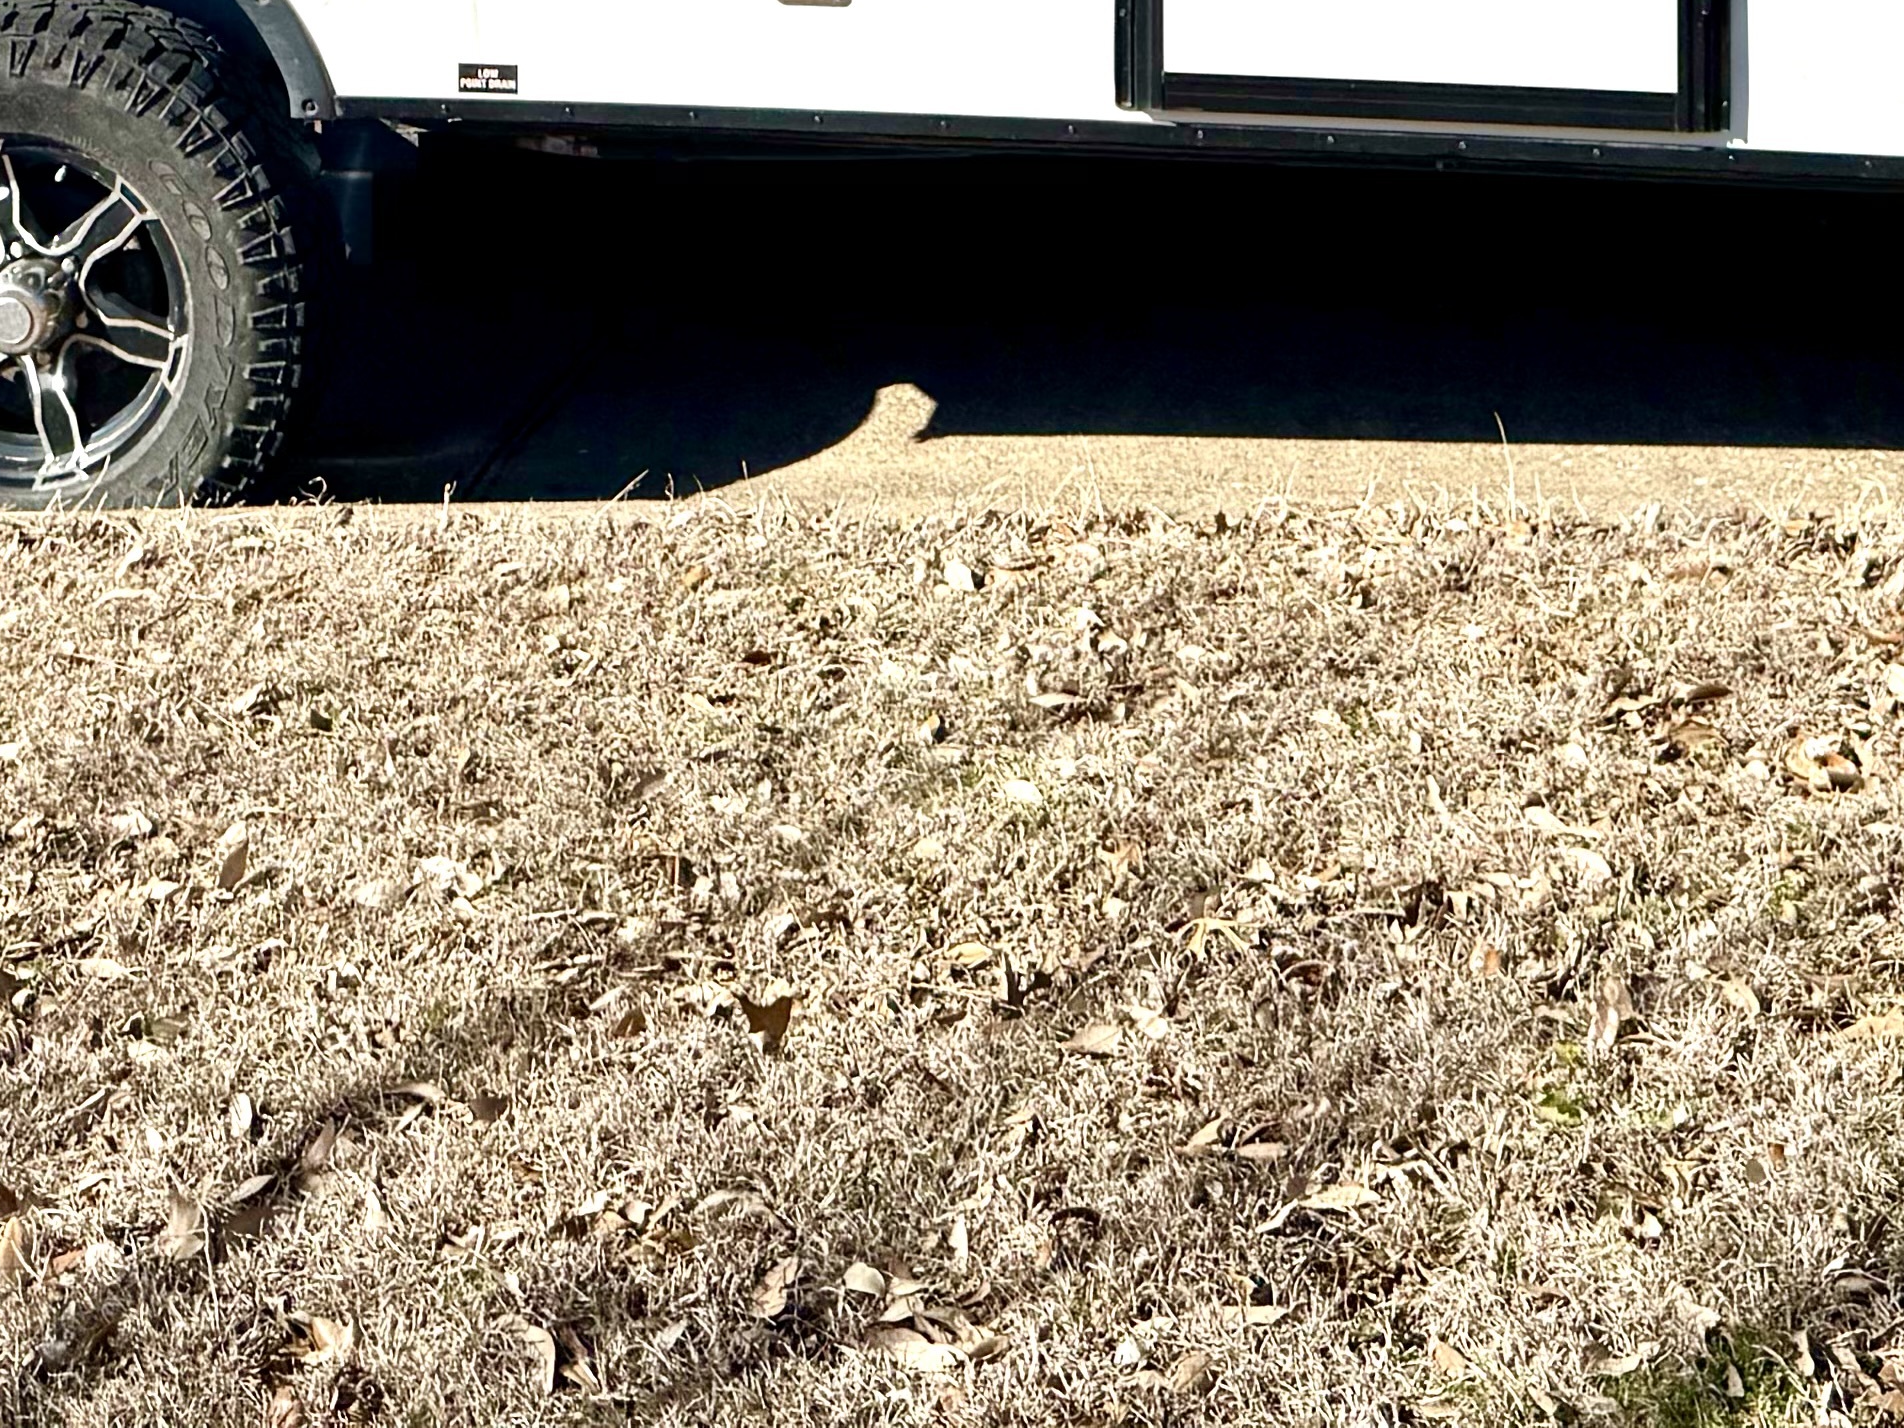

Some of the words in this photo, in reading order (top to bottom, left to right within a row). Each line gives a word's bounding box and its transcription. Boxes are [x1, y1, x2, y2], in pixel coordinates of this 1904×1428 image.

[477, 68, 499, 78] LOW
[460, 77, 487, 89] POINT
[488, 78, 516, 90] DRAIN
